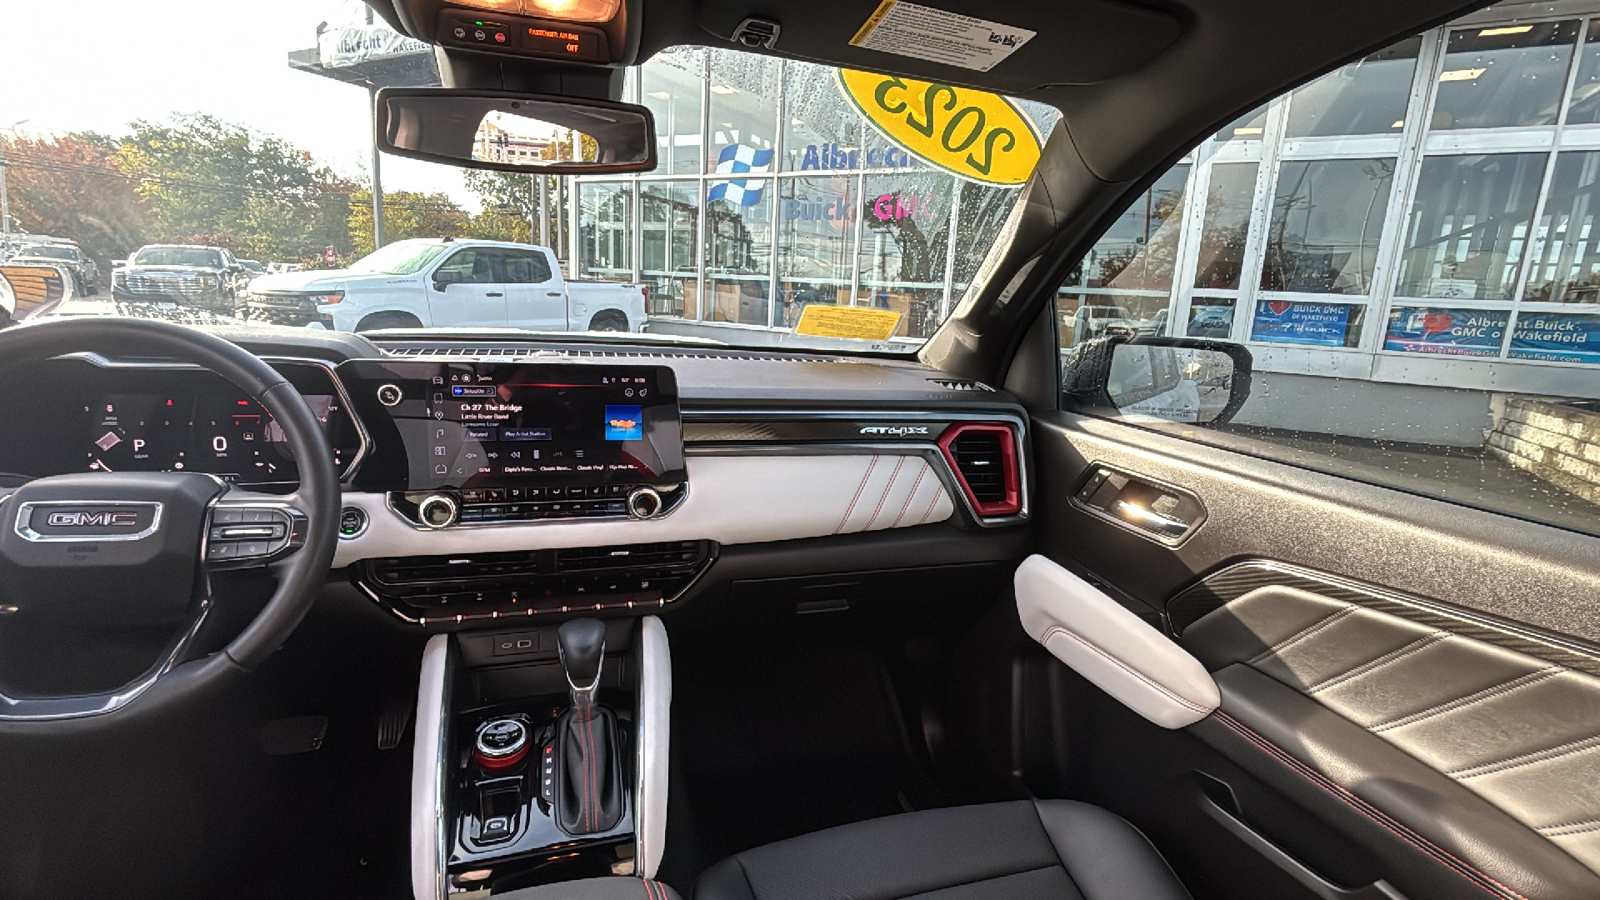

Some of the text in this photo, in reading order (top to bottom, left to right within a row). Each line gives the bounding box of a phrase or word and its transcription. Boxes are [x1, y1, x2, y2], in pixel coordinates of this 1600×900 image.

[336, 35, 382, 54] lbrecht
[566, 43, 579, 52] OFF
[801, 142, 917, 171] Albrec
[785, 193, 938, 220] Buick GMC
[1293, 304, 1321, 314] BUICK
[1323, 305, 1345, 315] GMC
[1301, 314, 1339, 322] WAKEFIELD
[1466, 316, 1530, 330] Albret
[1534, 319, 1575, 332] Buick
[1451, 326, 1487, 338] GMC
[1512, 330, 1588, 343] Wakefield
[499, 403, 523, 413] Bridge
[133, 439, 146, 452] P
[212, 436, 228, 452] 0
[48, 512, 138, 526] GMC
